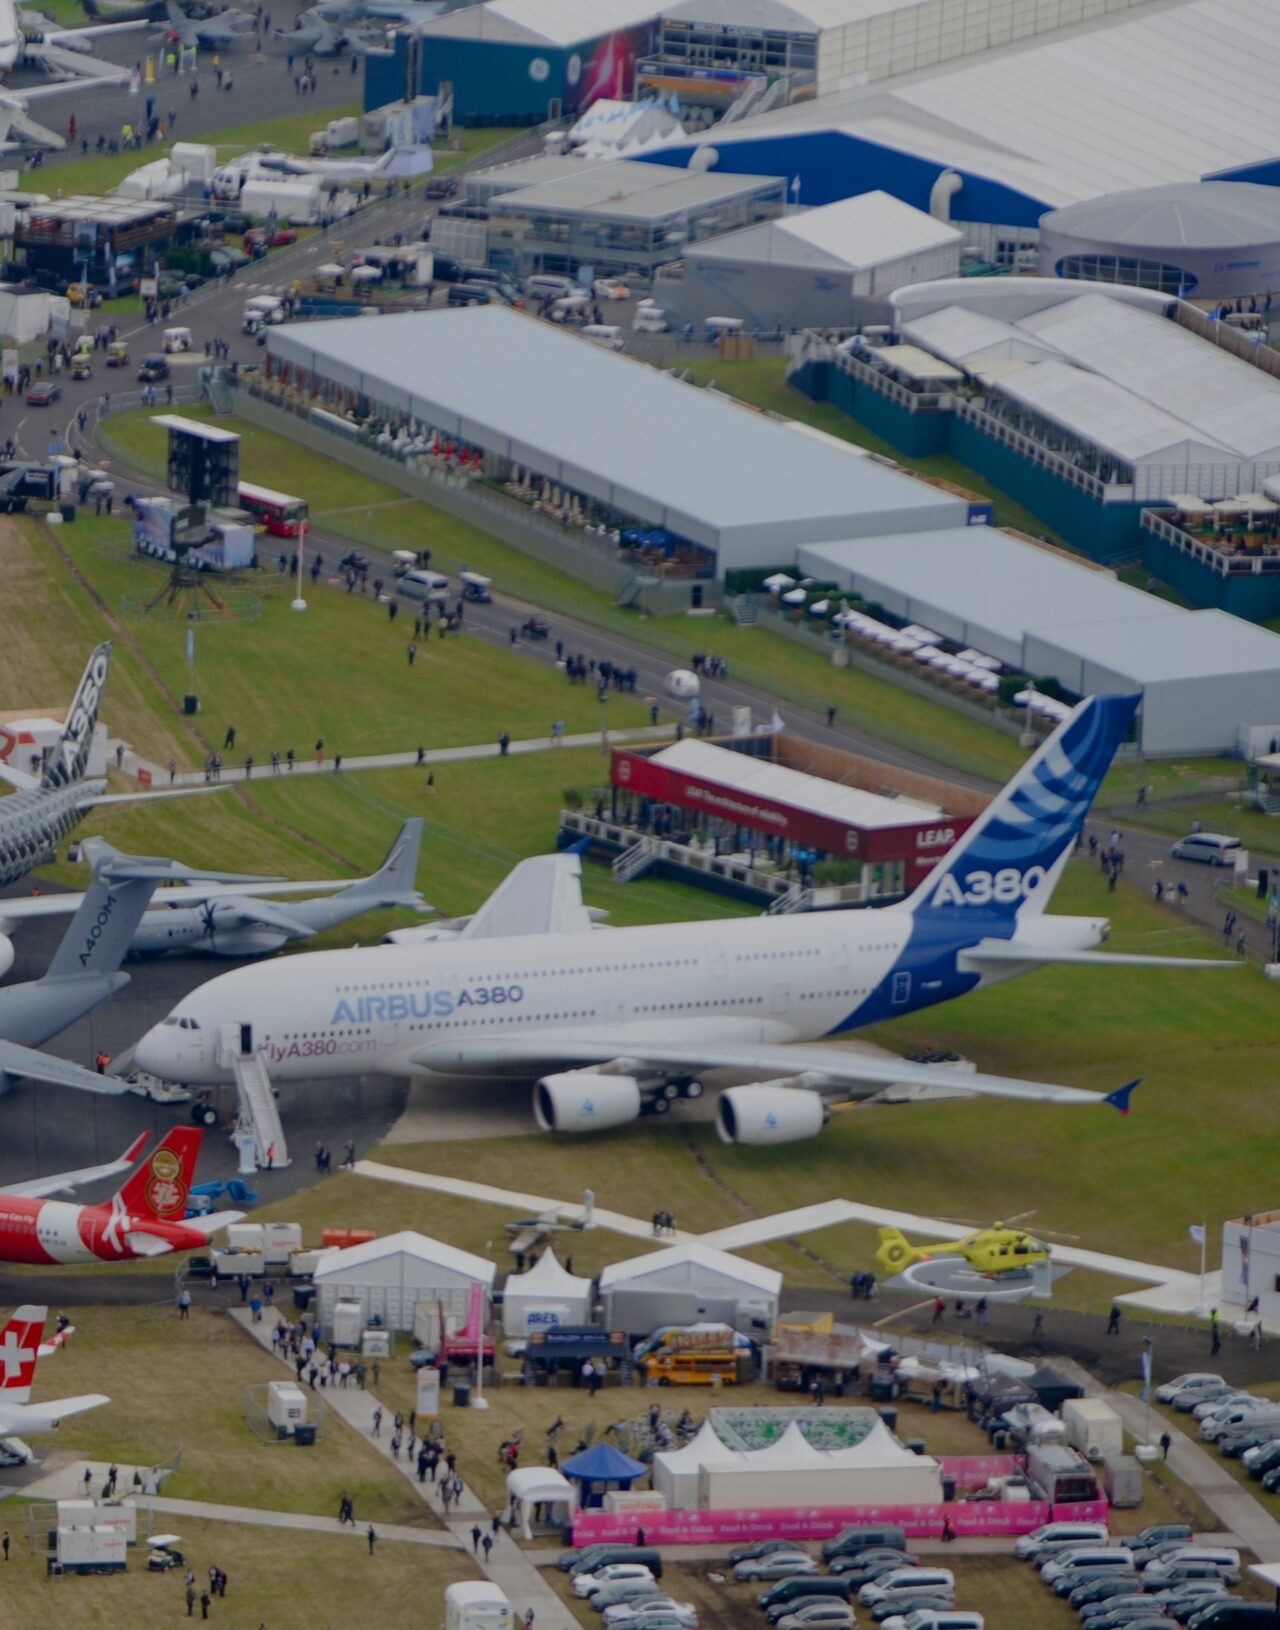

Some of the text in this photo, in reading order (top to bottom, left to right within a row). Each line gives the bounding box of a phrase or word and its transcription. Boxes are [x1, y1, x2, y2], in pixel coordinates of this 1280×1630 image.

[63, 654, 108, 775] A350
[930, 865, 1048, 908] A380
[79, 895, 118, 968] A400M
[330, 985, 524, 1025] AIRBUS A380
[8, 1212, 23, 1221] Can
[23, 1214, 35, 1225] Fly
[527, 1312, 560, 1326] AREA
